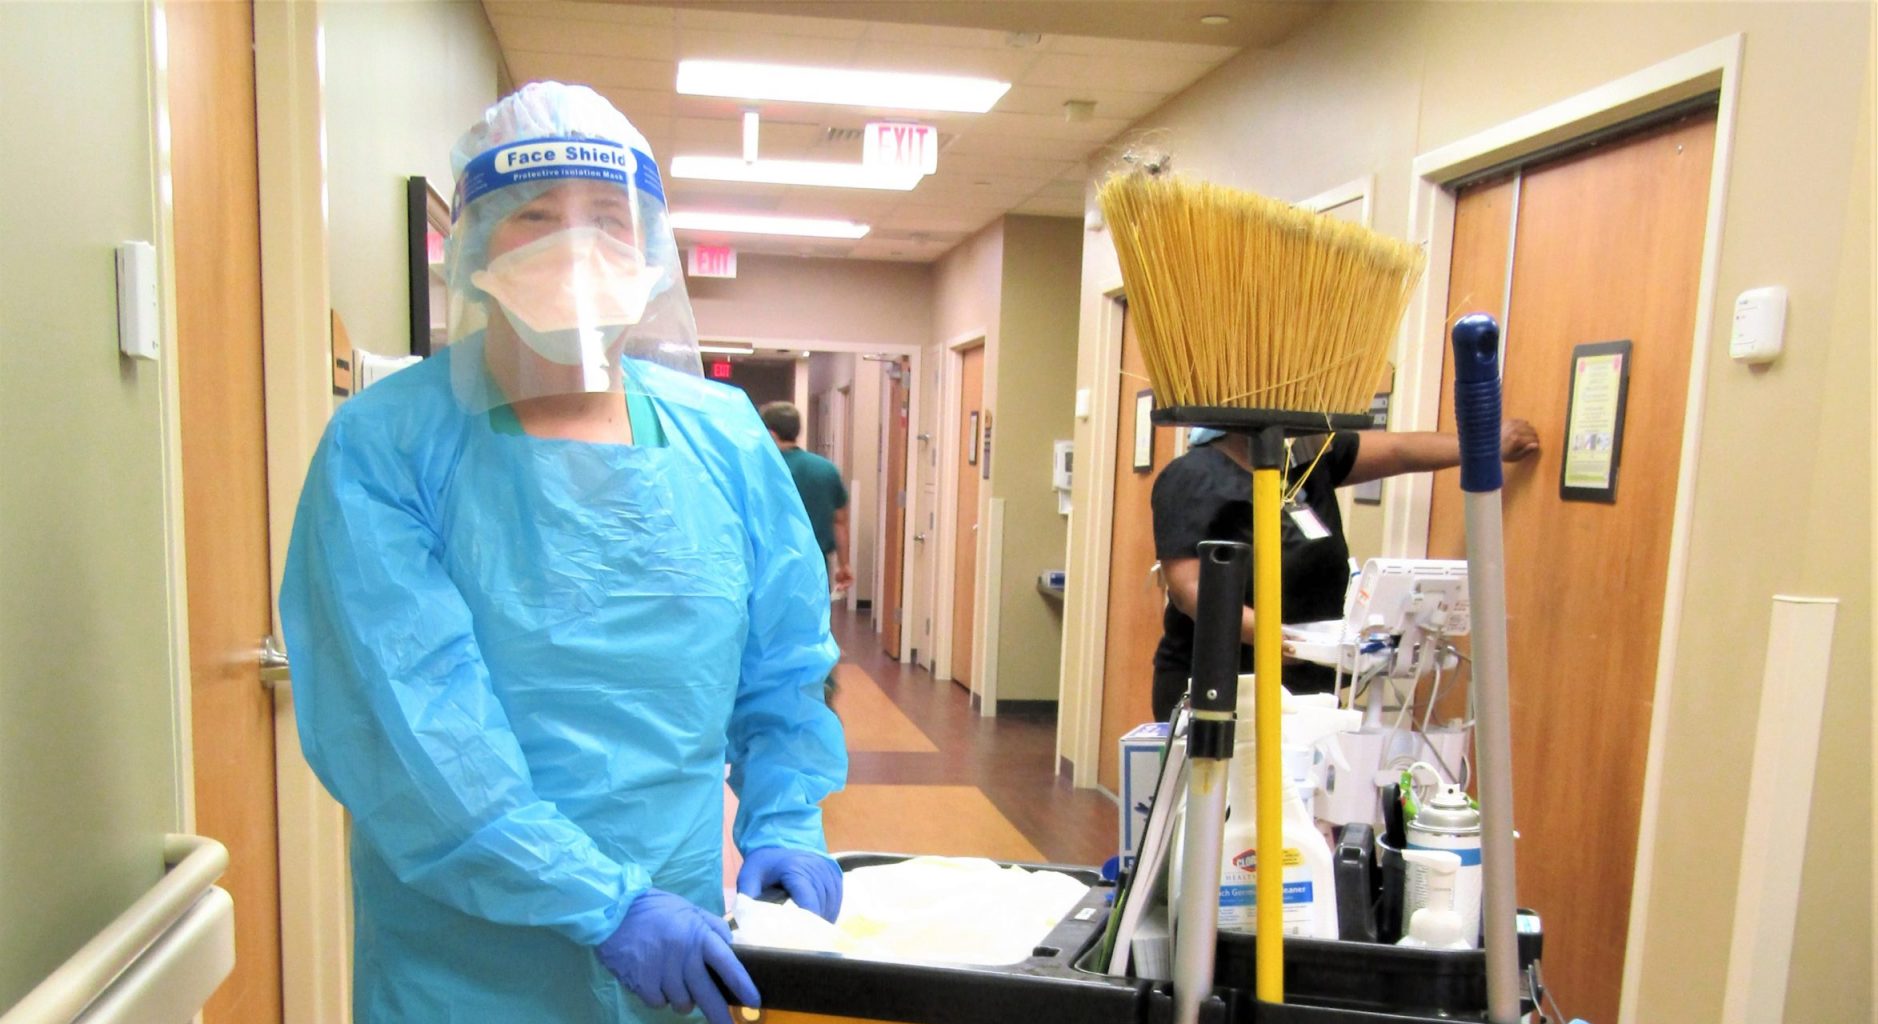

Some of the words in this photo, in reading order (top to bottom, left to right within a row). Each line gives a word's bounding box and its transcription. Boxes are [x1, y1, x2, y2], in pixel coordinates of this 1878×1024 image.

[507, 150, 556, 167] Face
[565, 146, 626, 167] Shield
[513, 169, 559, 182] Protective
[602, 171, 624, 181] Mask
[1283, 886, 1306, 895] eaner
